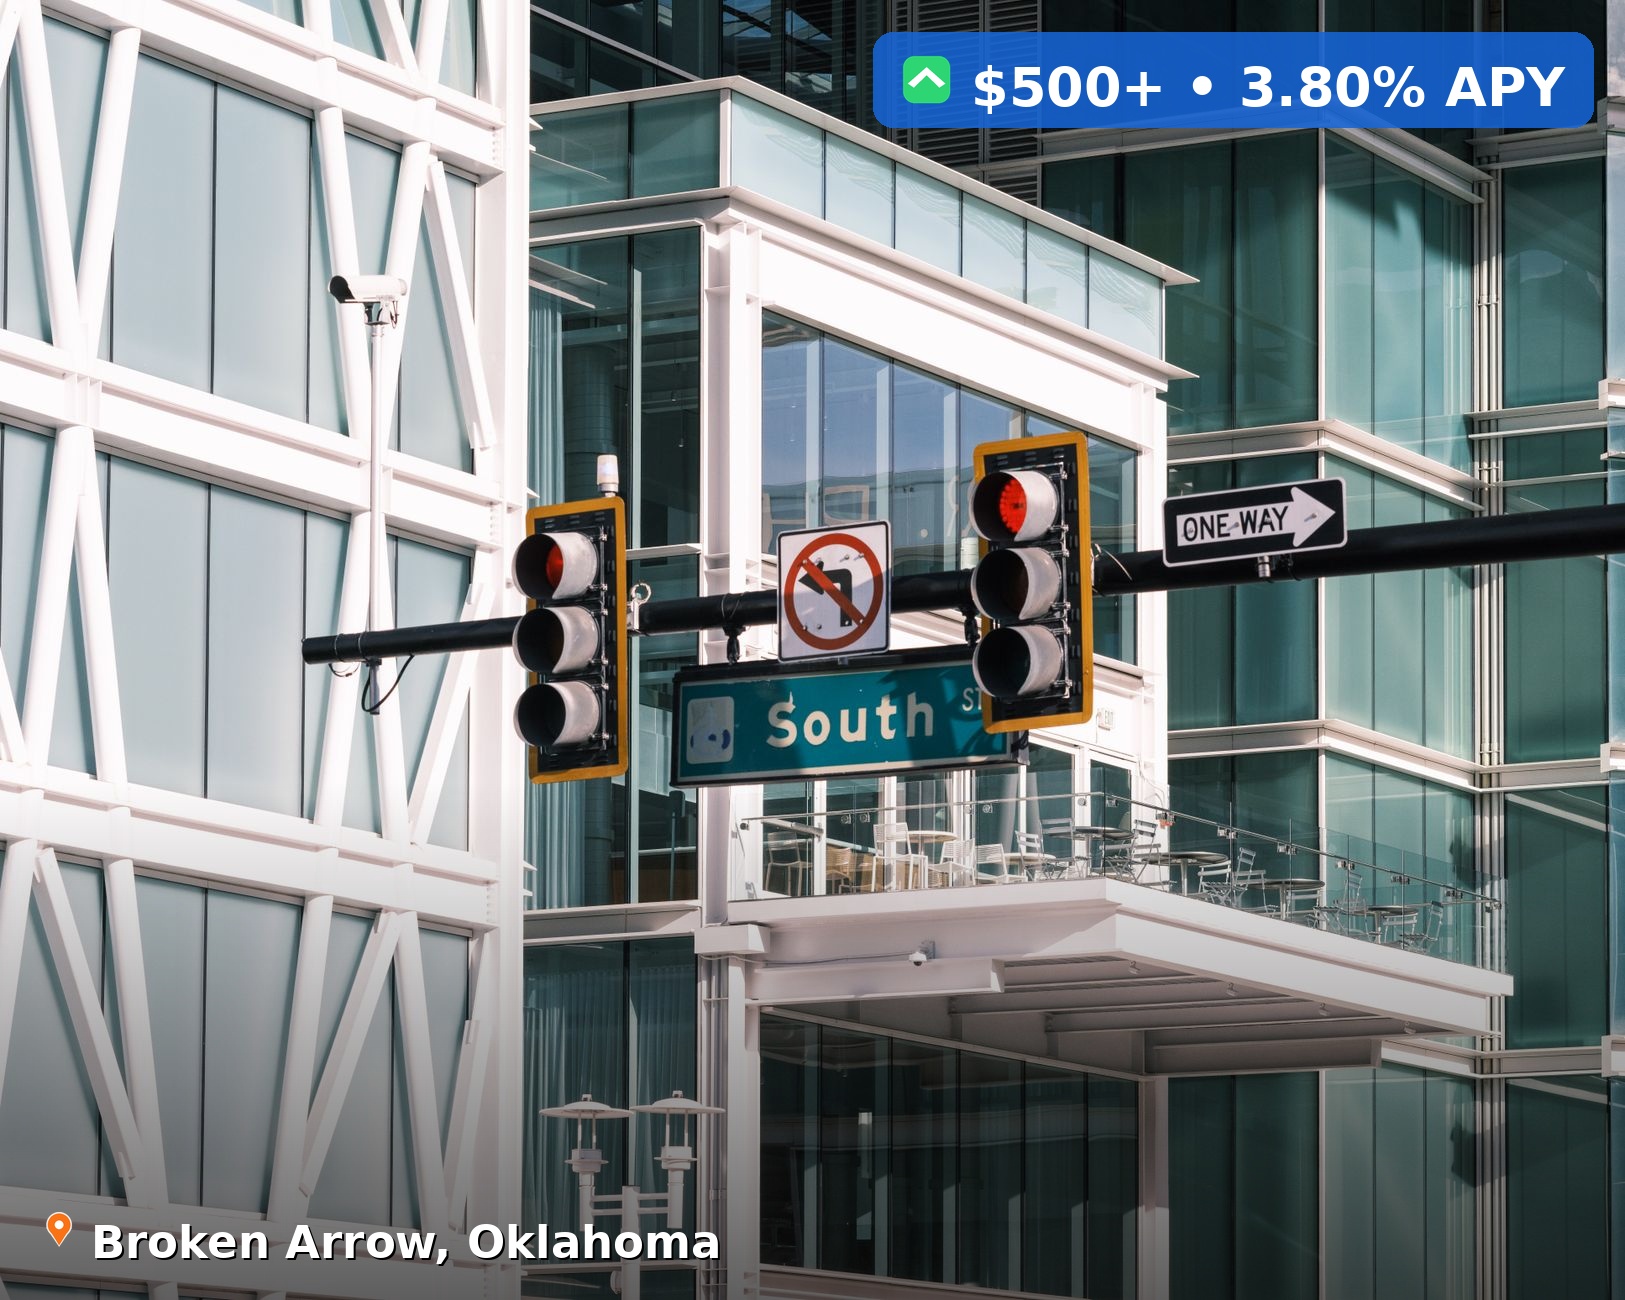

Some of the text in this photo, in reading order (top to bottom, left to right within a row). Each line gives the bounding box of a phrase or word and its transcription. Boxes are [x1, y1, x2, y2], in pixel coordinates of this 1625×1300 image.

[1183, 505, 1289, 542] ONE WAY
[962, 687, 983, 711] ST
[766, 690, 934, 748] South
